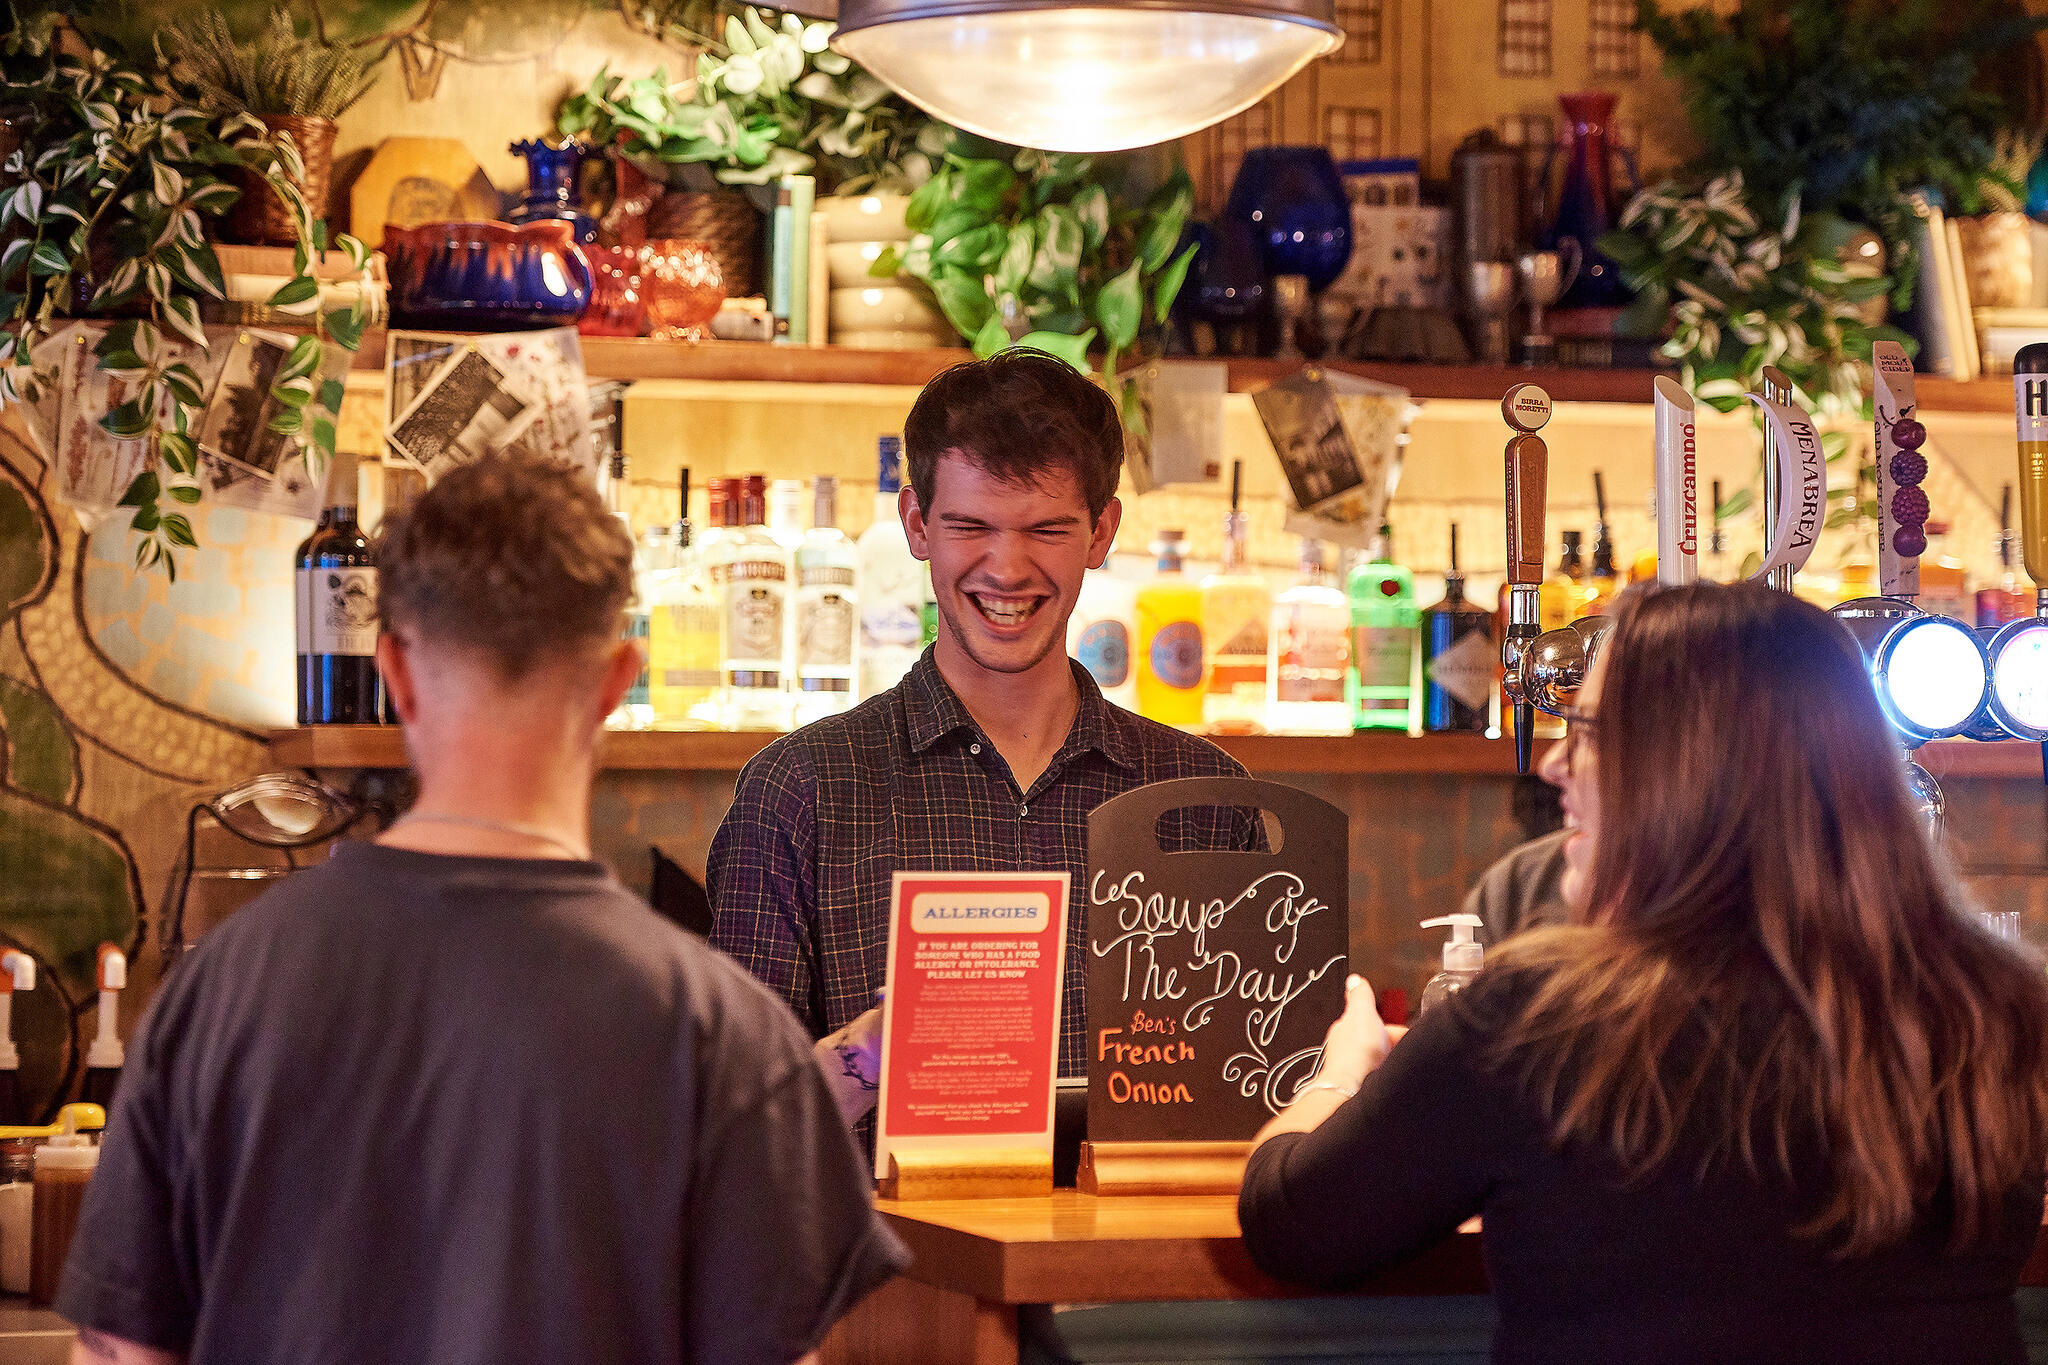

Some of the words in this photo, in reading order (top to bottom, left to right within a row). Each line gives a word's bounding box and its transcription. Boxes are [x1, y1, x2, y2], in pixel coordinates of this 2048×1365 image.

[1515, 404, 1549, 414] MORETTI
[1521, 398, 1544, 406] BIRRA
[1789, 421, 1820, 550] MENABREA
[923, 906, 1039, 920] ALLERGIES
[1090, 868, 1245, 958] Soup
[917, 941, 928, 951] IF
[929, 941, 949, 951] YOU
[950, 941, 970, 950] ARE
[970, 941, 1018, 950] ORDERING
[1019, 941, 1040, 950] FOR
[914, 951, 960, 960] SOMEONE
[962, 951, 985, 960] WHO
[985, 951, 1005, 960] HAS
[1006, 951, 1014, 960] A
[1014, 950, 1041, 960] FOOD
[914, 960, 956, 969] ALLERGY
[957, 960, 973, 969] OR
[927, 970, 963, 980] PLEASE
[964, 970, 983, 979] LET
[983, 970, 998, 979] US
[998, 970, 1027, 979] KNOW
[1091, 930, 1188, 1002] The
[1183, 950, 1348, 1047] Day
[1130, 1009, 1177, 1036] Ben's
[1096, 1027, 1196, 1066] French
[1107, 1070, 1195, 1105] Onion
